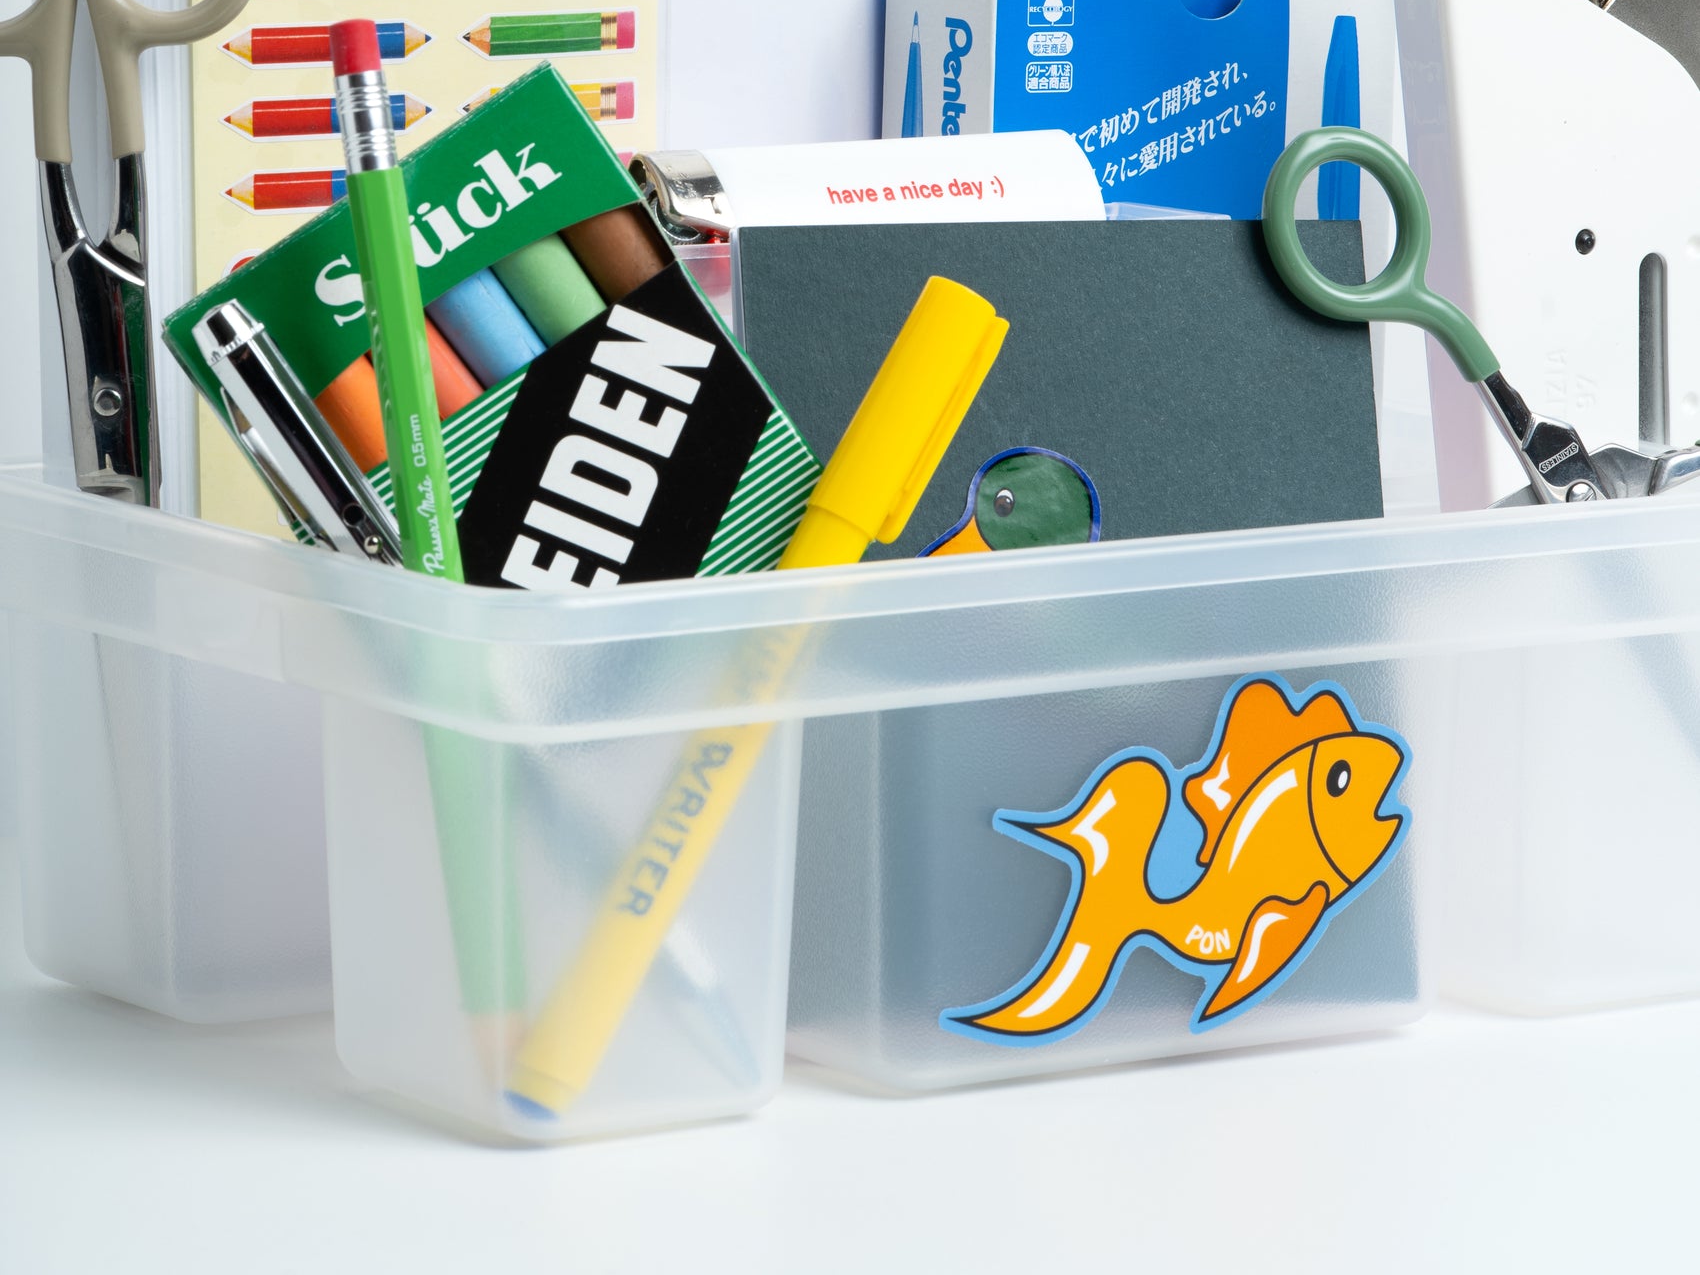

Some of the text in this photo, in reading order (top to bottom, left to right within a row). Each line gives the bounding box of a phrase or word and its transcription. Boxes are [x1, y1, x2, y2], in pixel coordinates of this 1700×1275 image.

[1032, 33, 1068, 43] エコマーク
[1032, 43, 1068, 55] 認定商品
[1027, 77, 1070, 90] 適合商品
[1072, 62, 1248, 154] で初めて開発され、
[1092, 90, 1276, 192] 々に愛用されている。
[826, 175, 1005, 205] have a nice day :)
[314, 142, 563, 327] Sück
[411, 413, 427, 468] 0.5mm
[1540, 443, 1578, 472] STAINLESS
[1185, 924, 1231, 954] PON
